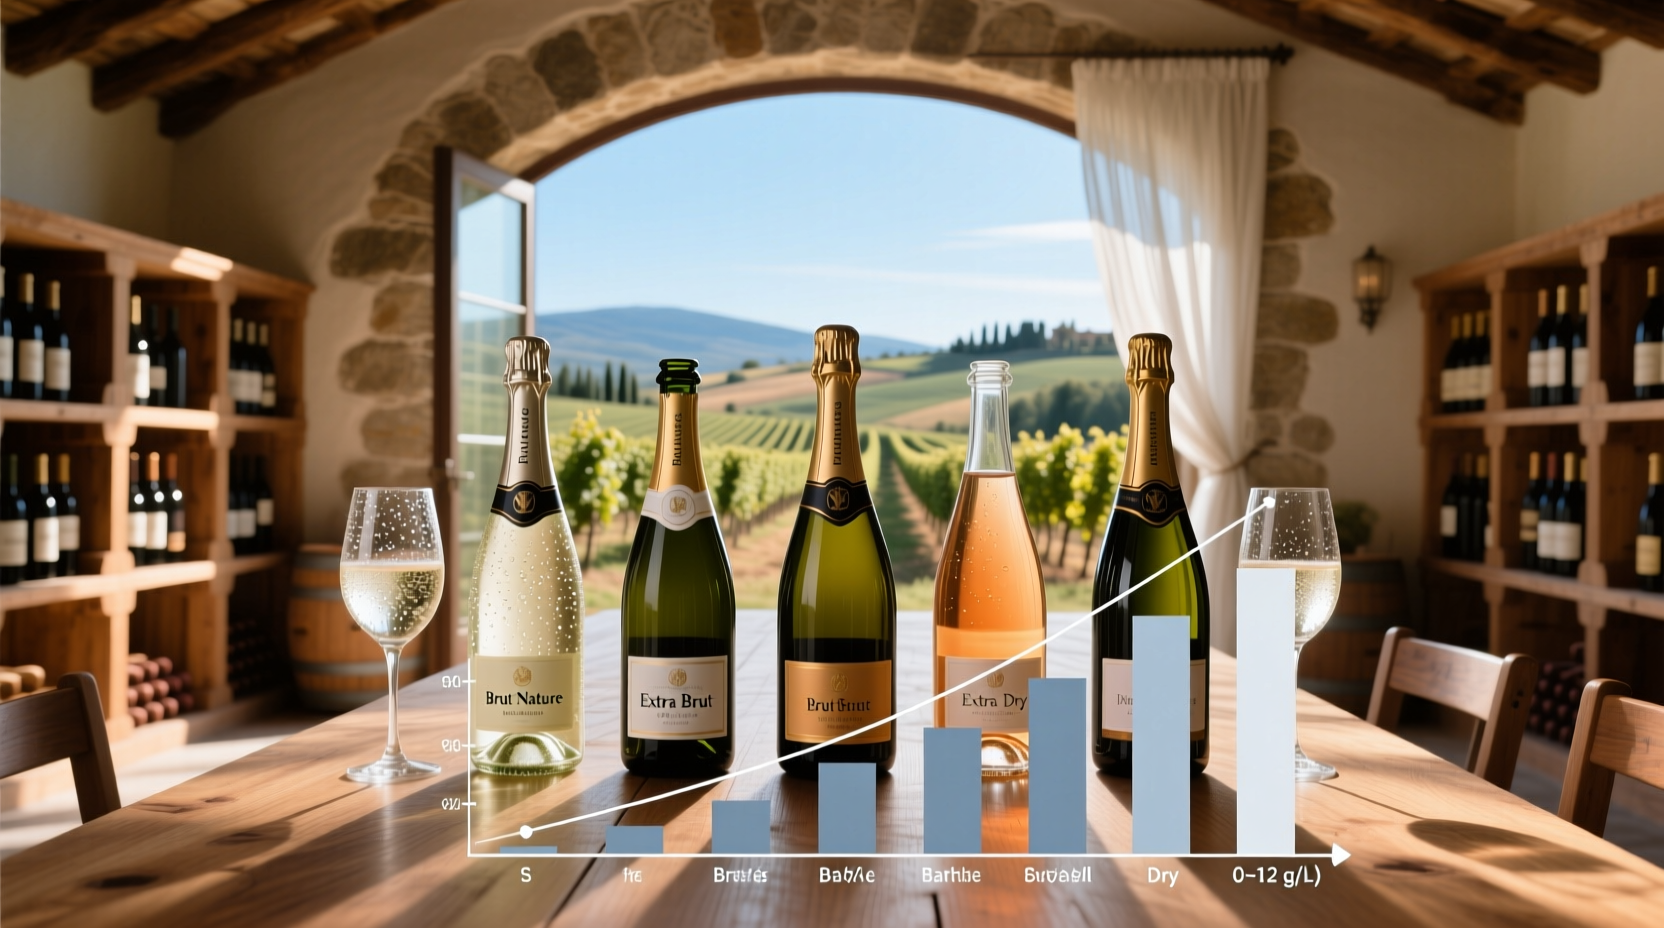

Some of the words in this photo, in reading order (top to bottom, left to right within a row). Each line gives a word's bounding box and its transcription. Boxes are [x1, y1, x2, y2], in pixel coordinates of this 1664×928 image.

[486, 691, 512, 706] Brut
[517, 691, 564, 706] Nature
[640, 692, 676, 709] Extra
[681, 693, 715, 709] Brut
[962, 692, 998, 708] Extra
[1003, 692, 1028, 711] Dry
